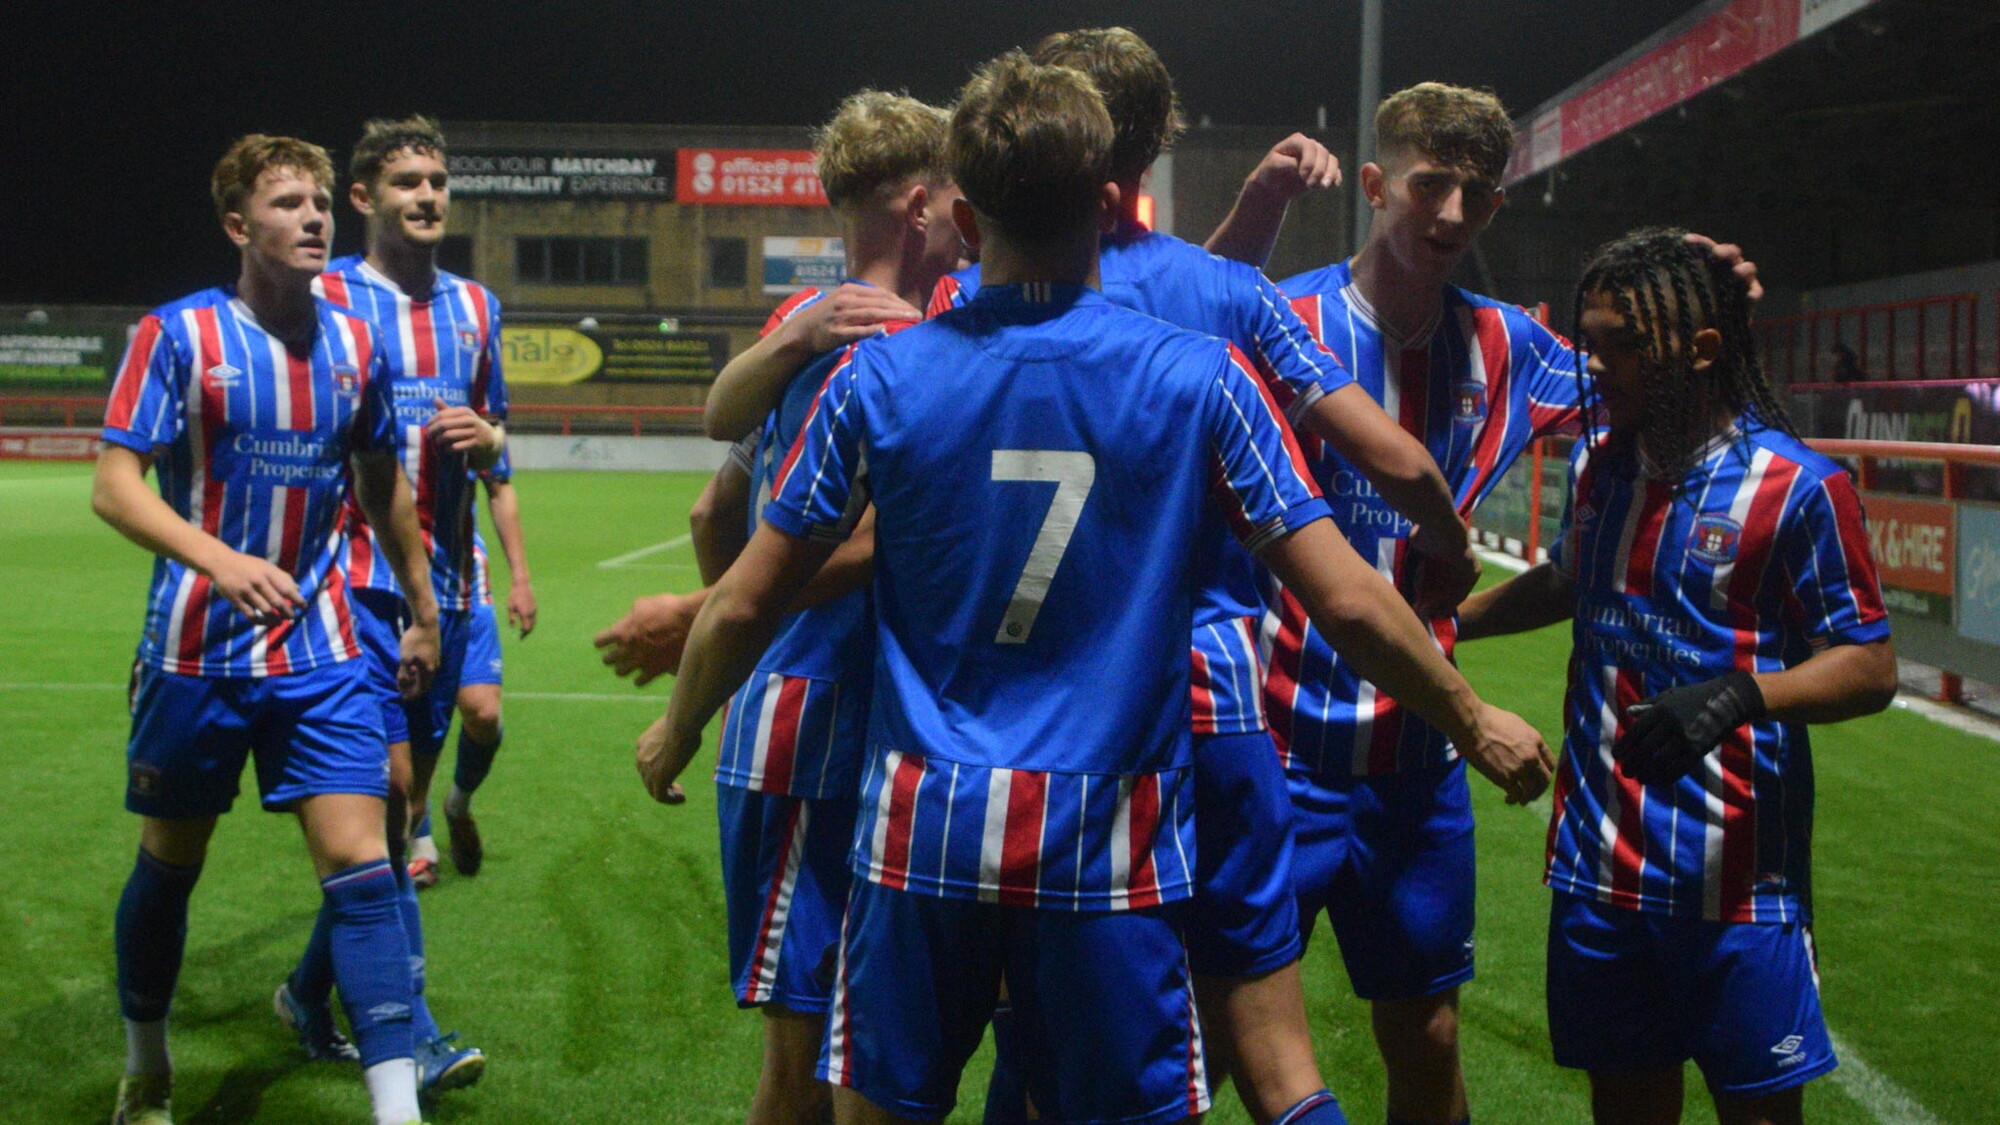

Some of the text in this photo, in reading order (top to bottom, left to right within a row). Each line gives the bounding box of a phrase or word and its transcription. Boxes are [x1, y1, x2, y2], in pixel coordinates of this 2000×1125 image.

[501, 156, 547, 172] YOUR
[551, 157, 657, 175] MATCHDAY
[569, 176, 669, 193] EXPERIENCE
[721, 175, 825, 195] 01524 41
[393, 381, 467, 403] umbrian
[991, 450, 1096, 643] 7
